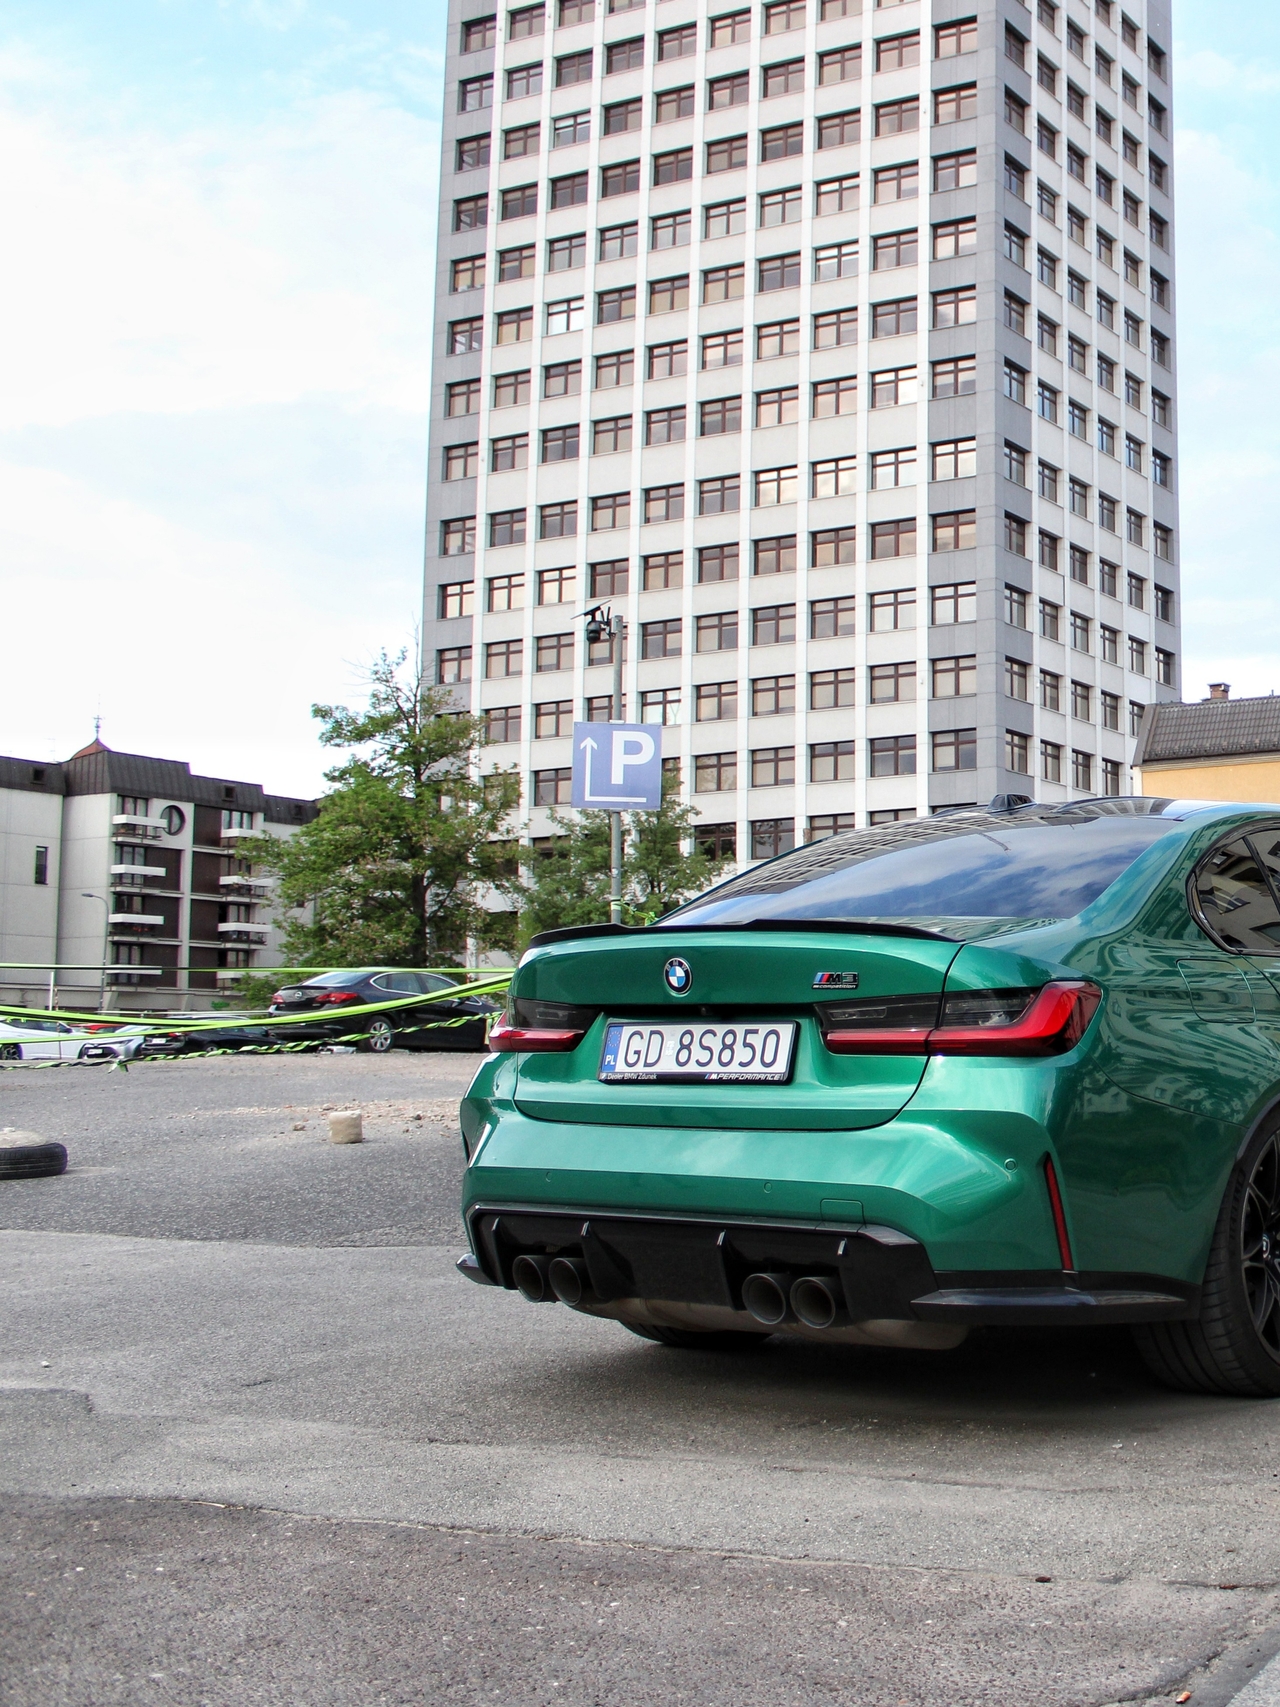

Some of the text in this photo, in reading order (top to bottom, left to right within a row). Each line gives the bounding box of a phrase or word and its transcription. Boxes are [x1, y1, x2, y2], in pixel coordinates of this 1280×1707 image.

[611, 731, 655, 785] P
[825, 972, 858, 985] M3
[624, 1028, 781, 1069] GD 8S850
[604, 1054, 616, 1066] PL
[638, 1072, 657, 1080] Zdunek
